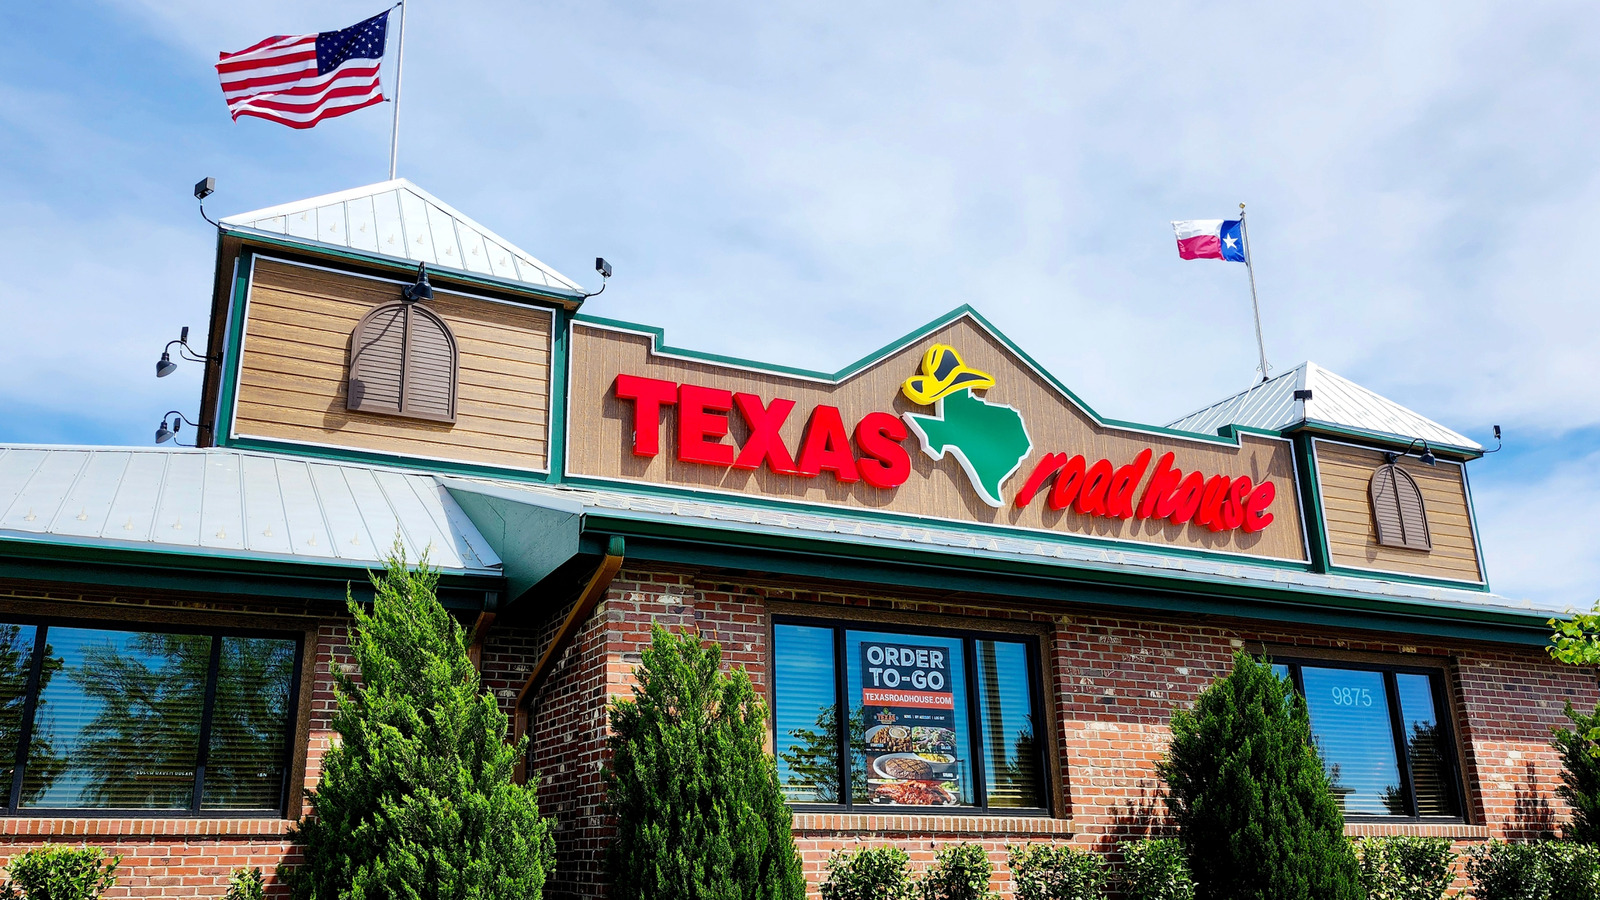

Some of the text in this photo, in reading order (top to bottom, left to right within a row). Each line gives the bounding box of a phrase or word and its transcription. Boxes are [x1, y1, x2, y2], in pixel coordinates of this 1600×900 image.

[615, 373, 911, 489] TEXAS
[866, 645, 944, 669] ORDER
[868, 667, 945, 690] TO-GO
[865, 692, 952, 705] TEXASROADHOUSE.COM
[1331, 686, 1372, 707] 9875
